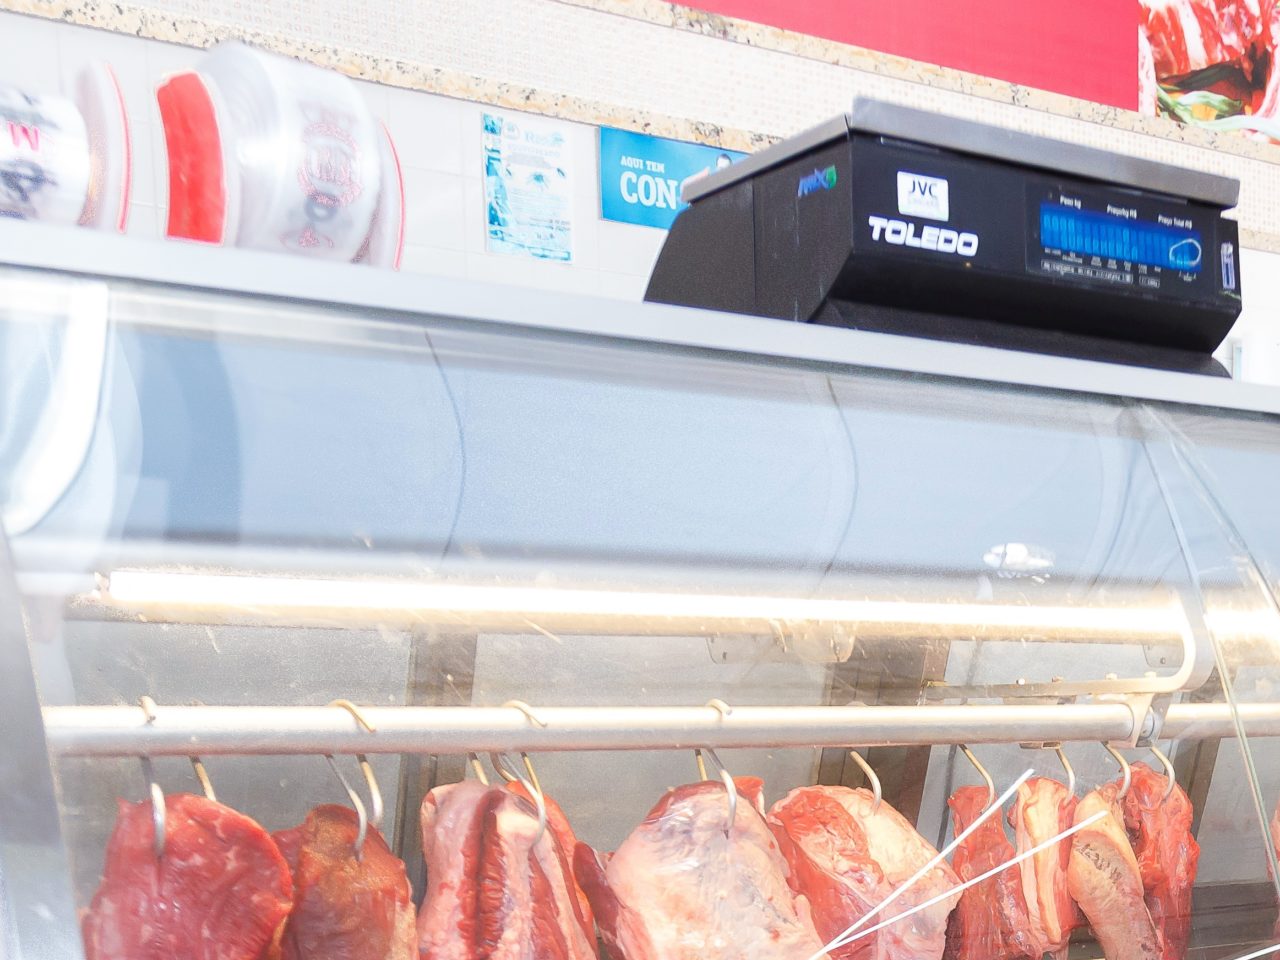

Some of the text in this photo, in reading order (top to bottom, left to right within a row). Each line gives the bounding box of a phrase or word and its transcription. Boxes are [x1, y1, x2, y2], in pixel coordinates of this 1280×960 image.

[620, 155, 665, 173] AQUI TEM
[909, 179, 938, 199] JVC
[868, 215, 979, 257] TOLEDO
